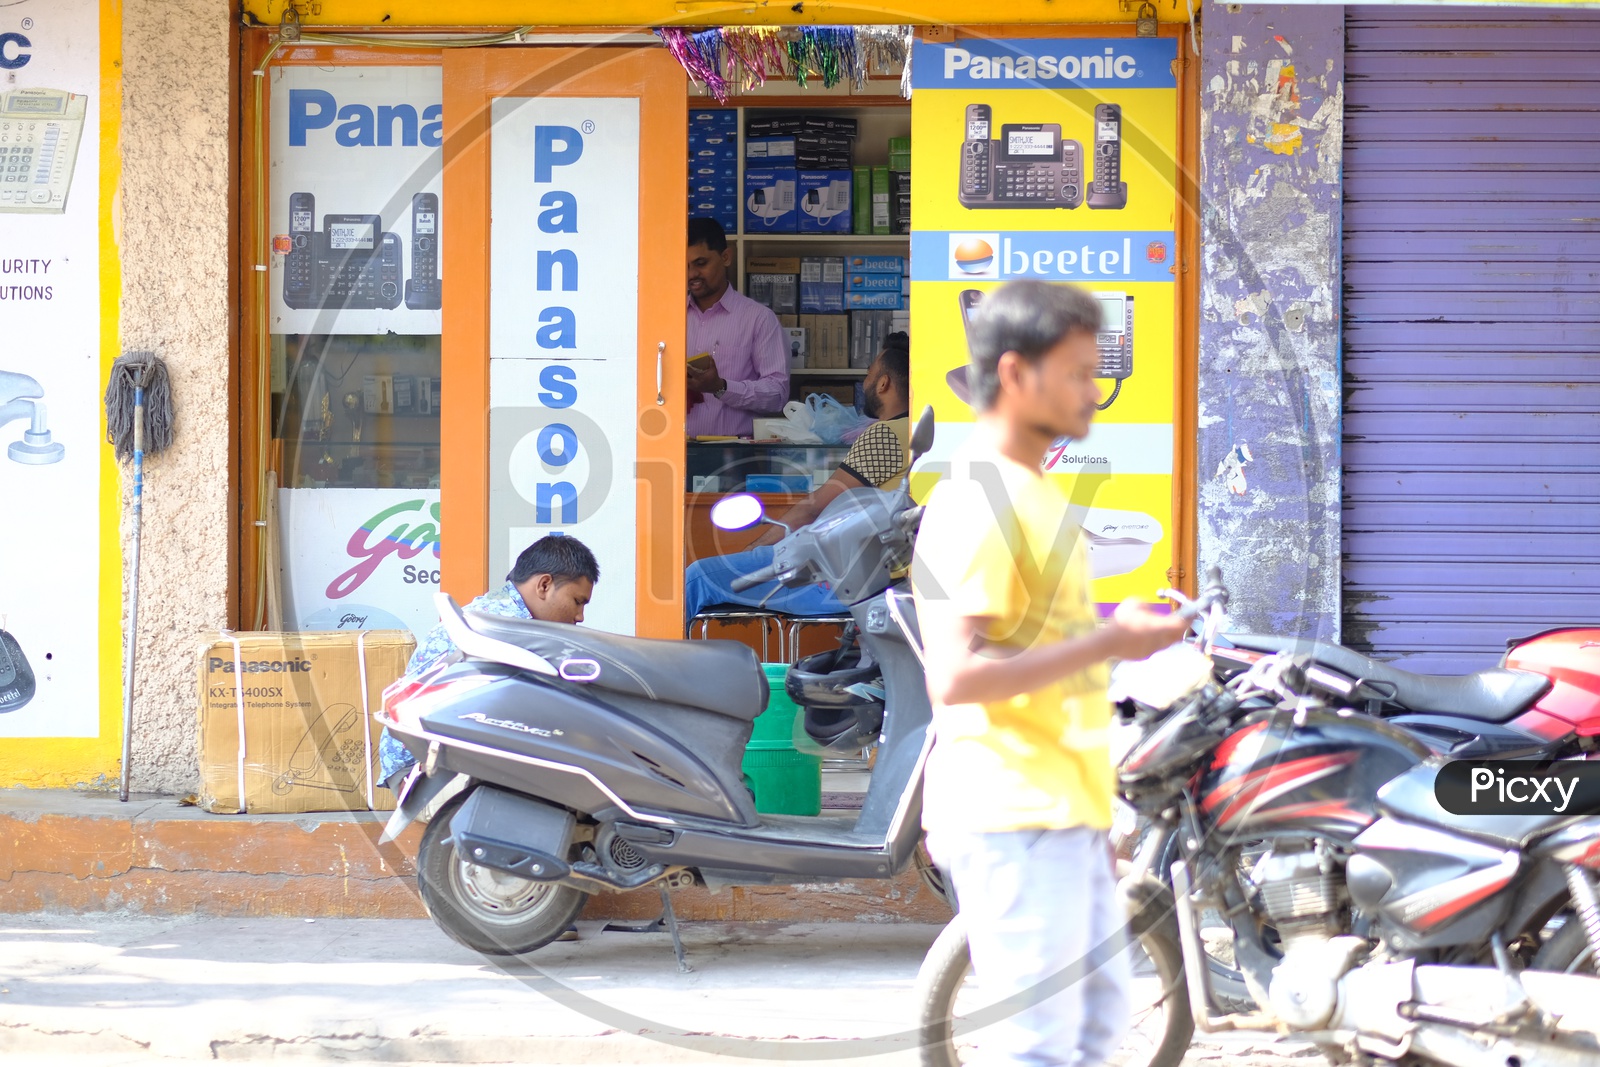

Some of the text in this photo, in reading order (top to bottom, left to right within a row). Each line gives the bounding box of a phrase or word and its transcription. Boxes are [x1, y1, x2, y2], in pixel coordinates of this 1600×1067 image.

[944, 47, 1136, 79] Panasonic
[1003, 237, 1131, 275] beetel
[864, 258, 898, 269] beetel
[864, 276, 898, 287] beetel
[863, 294, 898, 305] beetel
[534, 125, 584, 537] Panason
[1061, 454, 1108, 464] Solutions
[337, 613, 368, 629] Godrej
[247, 701, 283, 709] Telephone
[285, 701, 312, 709] System
